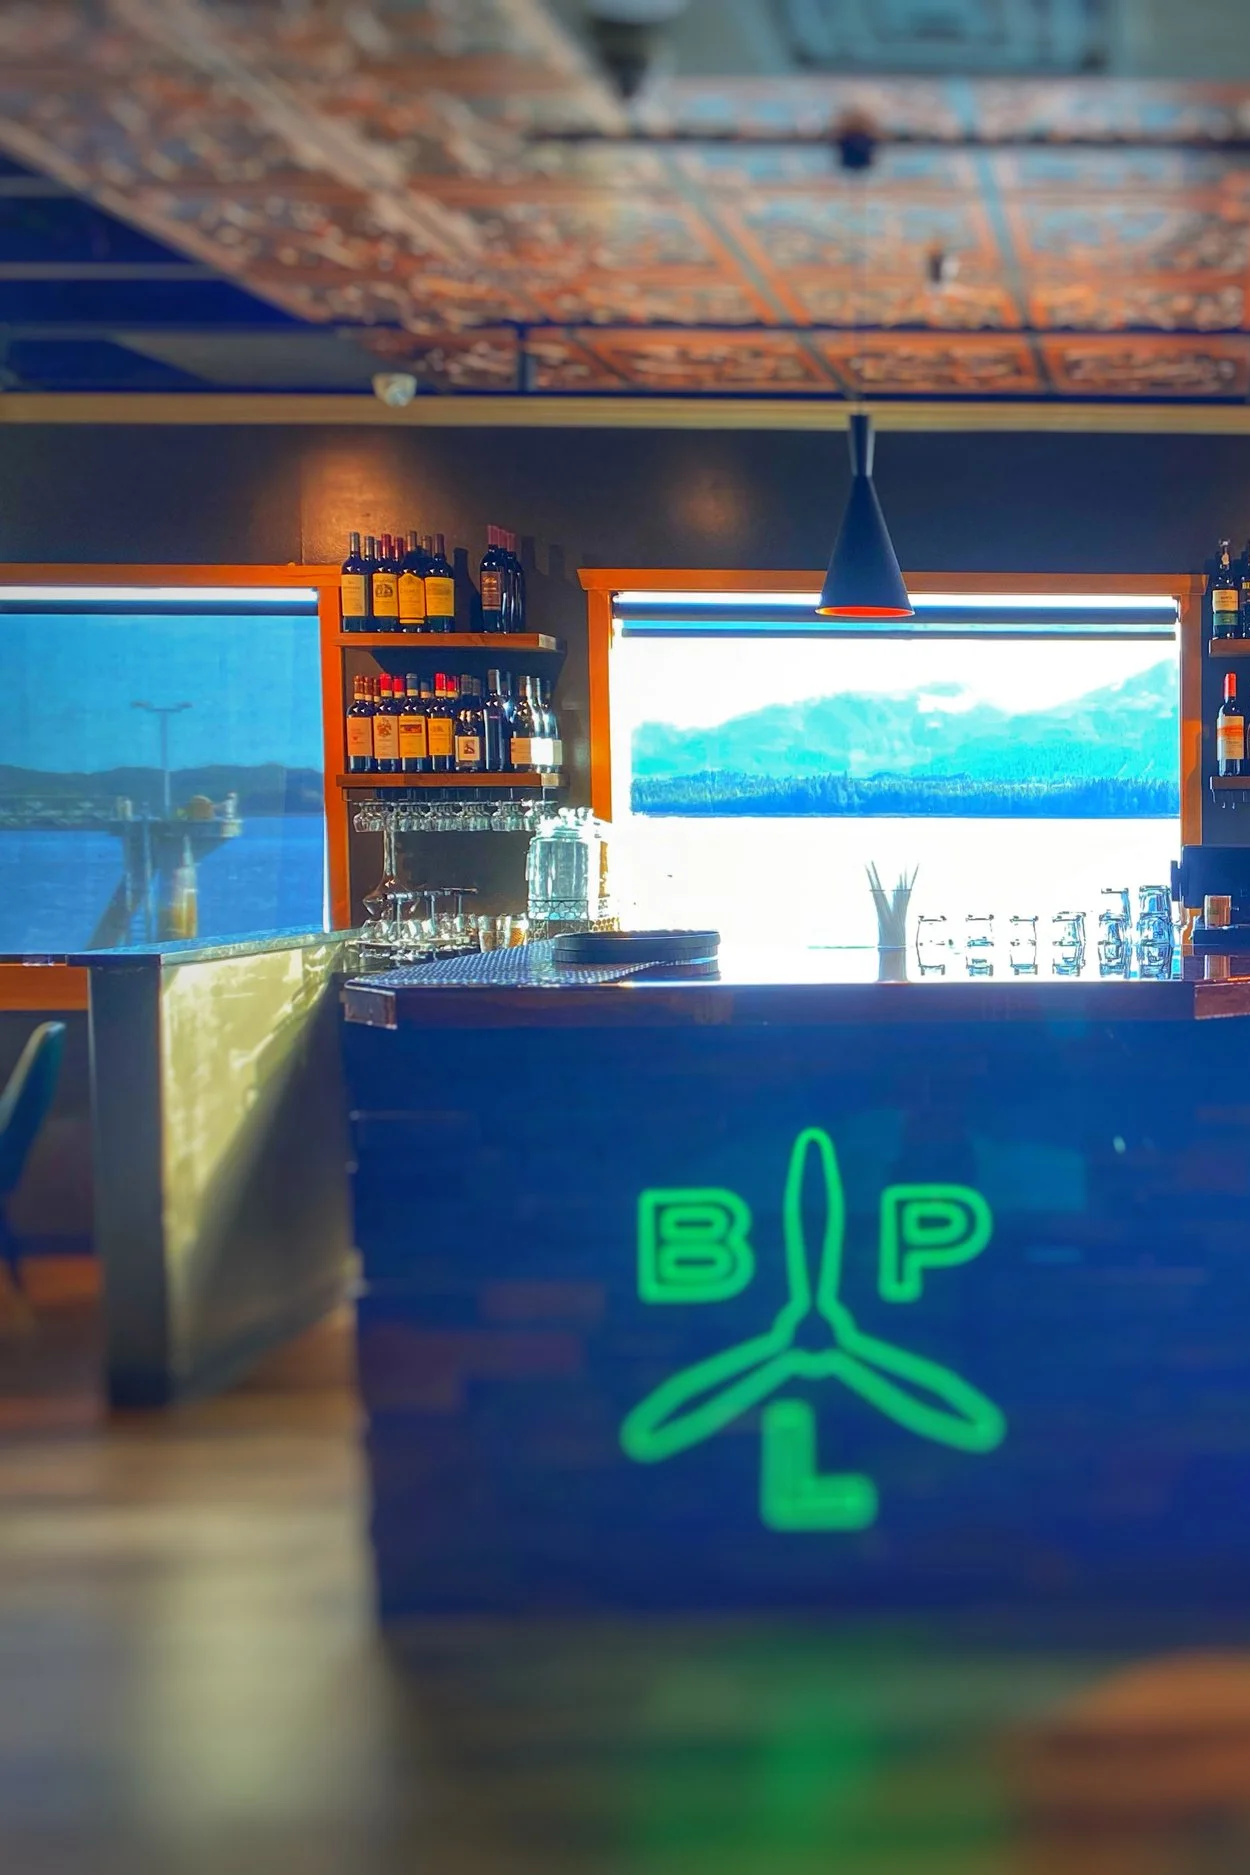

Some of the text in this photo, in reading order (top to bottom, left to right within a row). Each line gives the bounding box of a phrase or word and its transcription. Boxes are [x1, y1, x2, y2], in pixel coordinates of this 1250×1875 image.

[637, 1182, 993, 1304] B P
[759, 1397, 879, 1533] L
